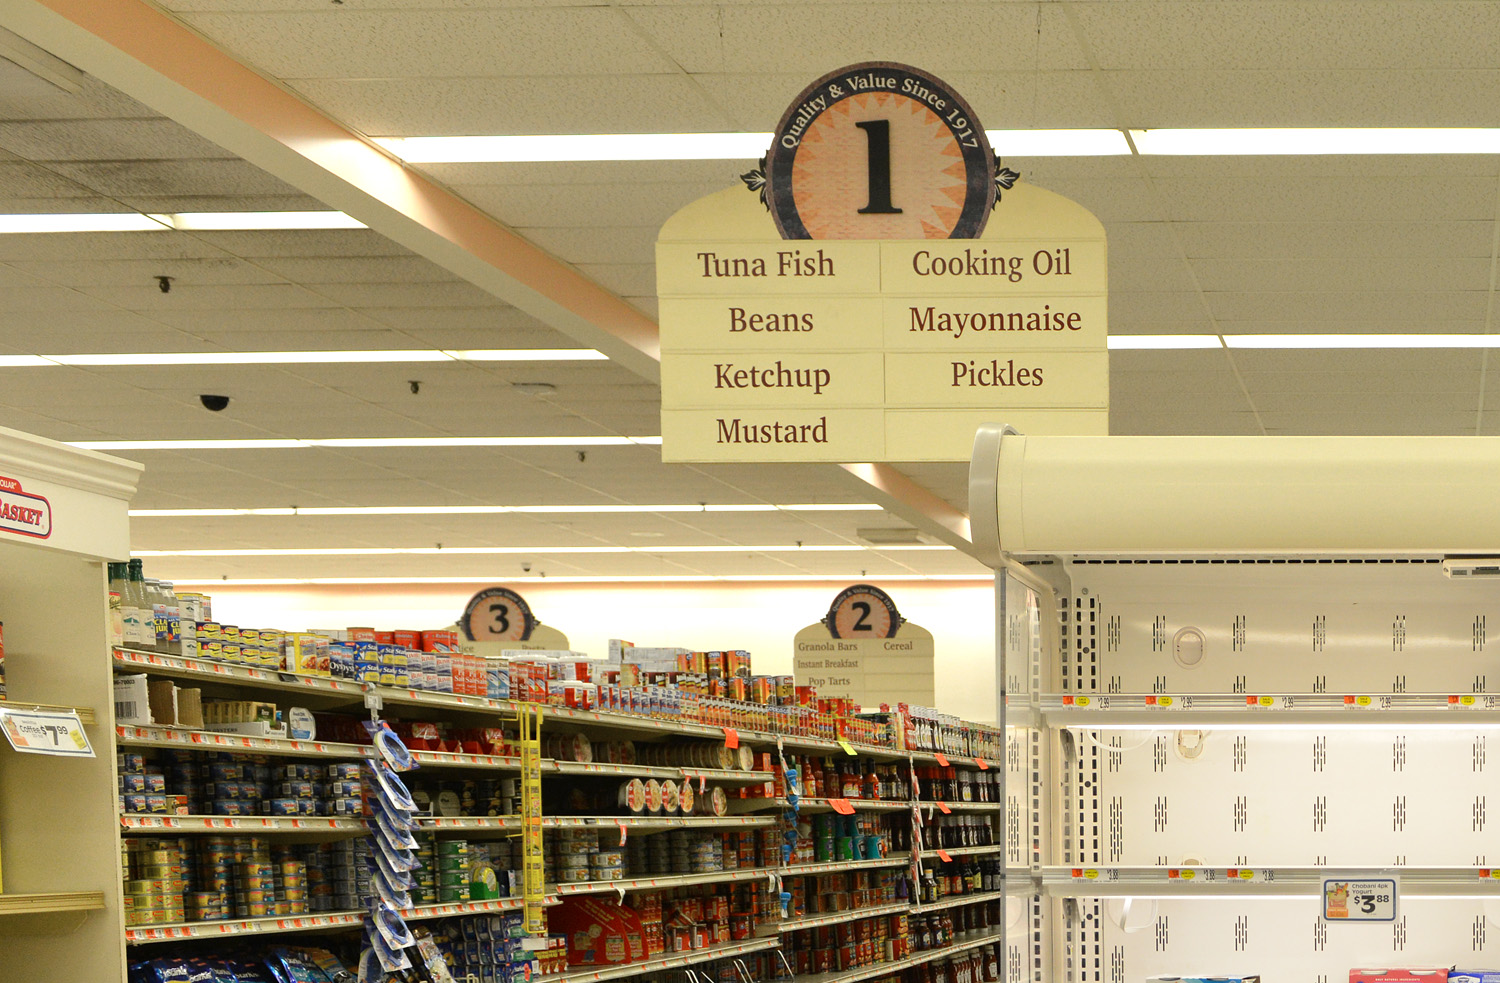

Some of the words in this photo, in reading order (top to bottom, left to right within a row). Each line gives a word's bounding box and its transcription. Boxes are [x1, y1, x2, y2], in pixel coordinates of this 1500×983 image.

[781, 93, 829, 150] Quality
[829, 82, 845, 97] &
[847, 73, 897, 90] Value
[902, 77, 946, 111] Since
[946, 108, 978, 150] 1917
[855, 119, 903, 214] 1
[697, 252, 767, 277] Tuna
[777, 249, 835, 276] Fish
[912, 249, 1023, 282] Cooking
[1032, 248, 1072, 275] Oil
[729, 307, 814, 332] Beans
[909, 305, 1082, 338] Mayonnaise
[714, 361, 831, 394] Ketchup
[951, 360, 1043, 387] Pickles
[716, 416, 828, 443] Mustard
[0, 479, 16, 489] OLLAR
[0, 498, 43, 526] ASKET
[488, 604, 509, 634] 3
[852, 602, 872, 631] 2
[798, 642, 835, 651] Granola
[837, 642, 858, 650] Bars
[884, 641, 913, 650] Cereal
[797, 660, 823, 668] Instant
[825, 659, 858, 668] Breakfast
[808, 677, 825, 688] Pop
[828, 676, 850, 685] Tarts
[20, 725, 41, 734] Coffee
